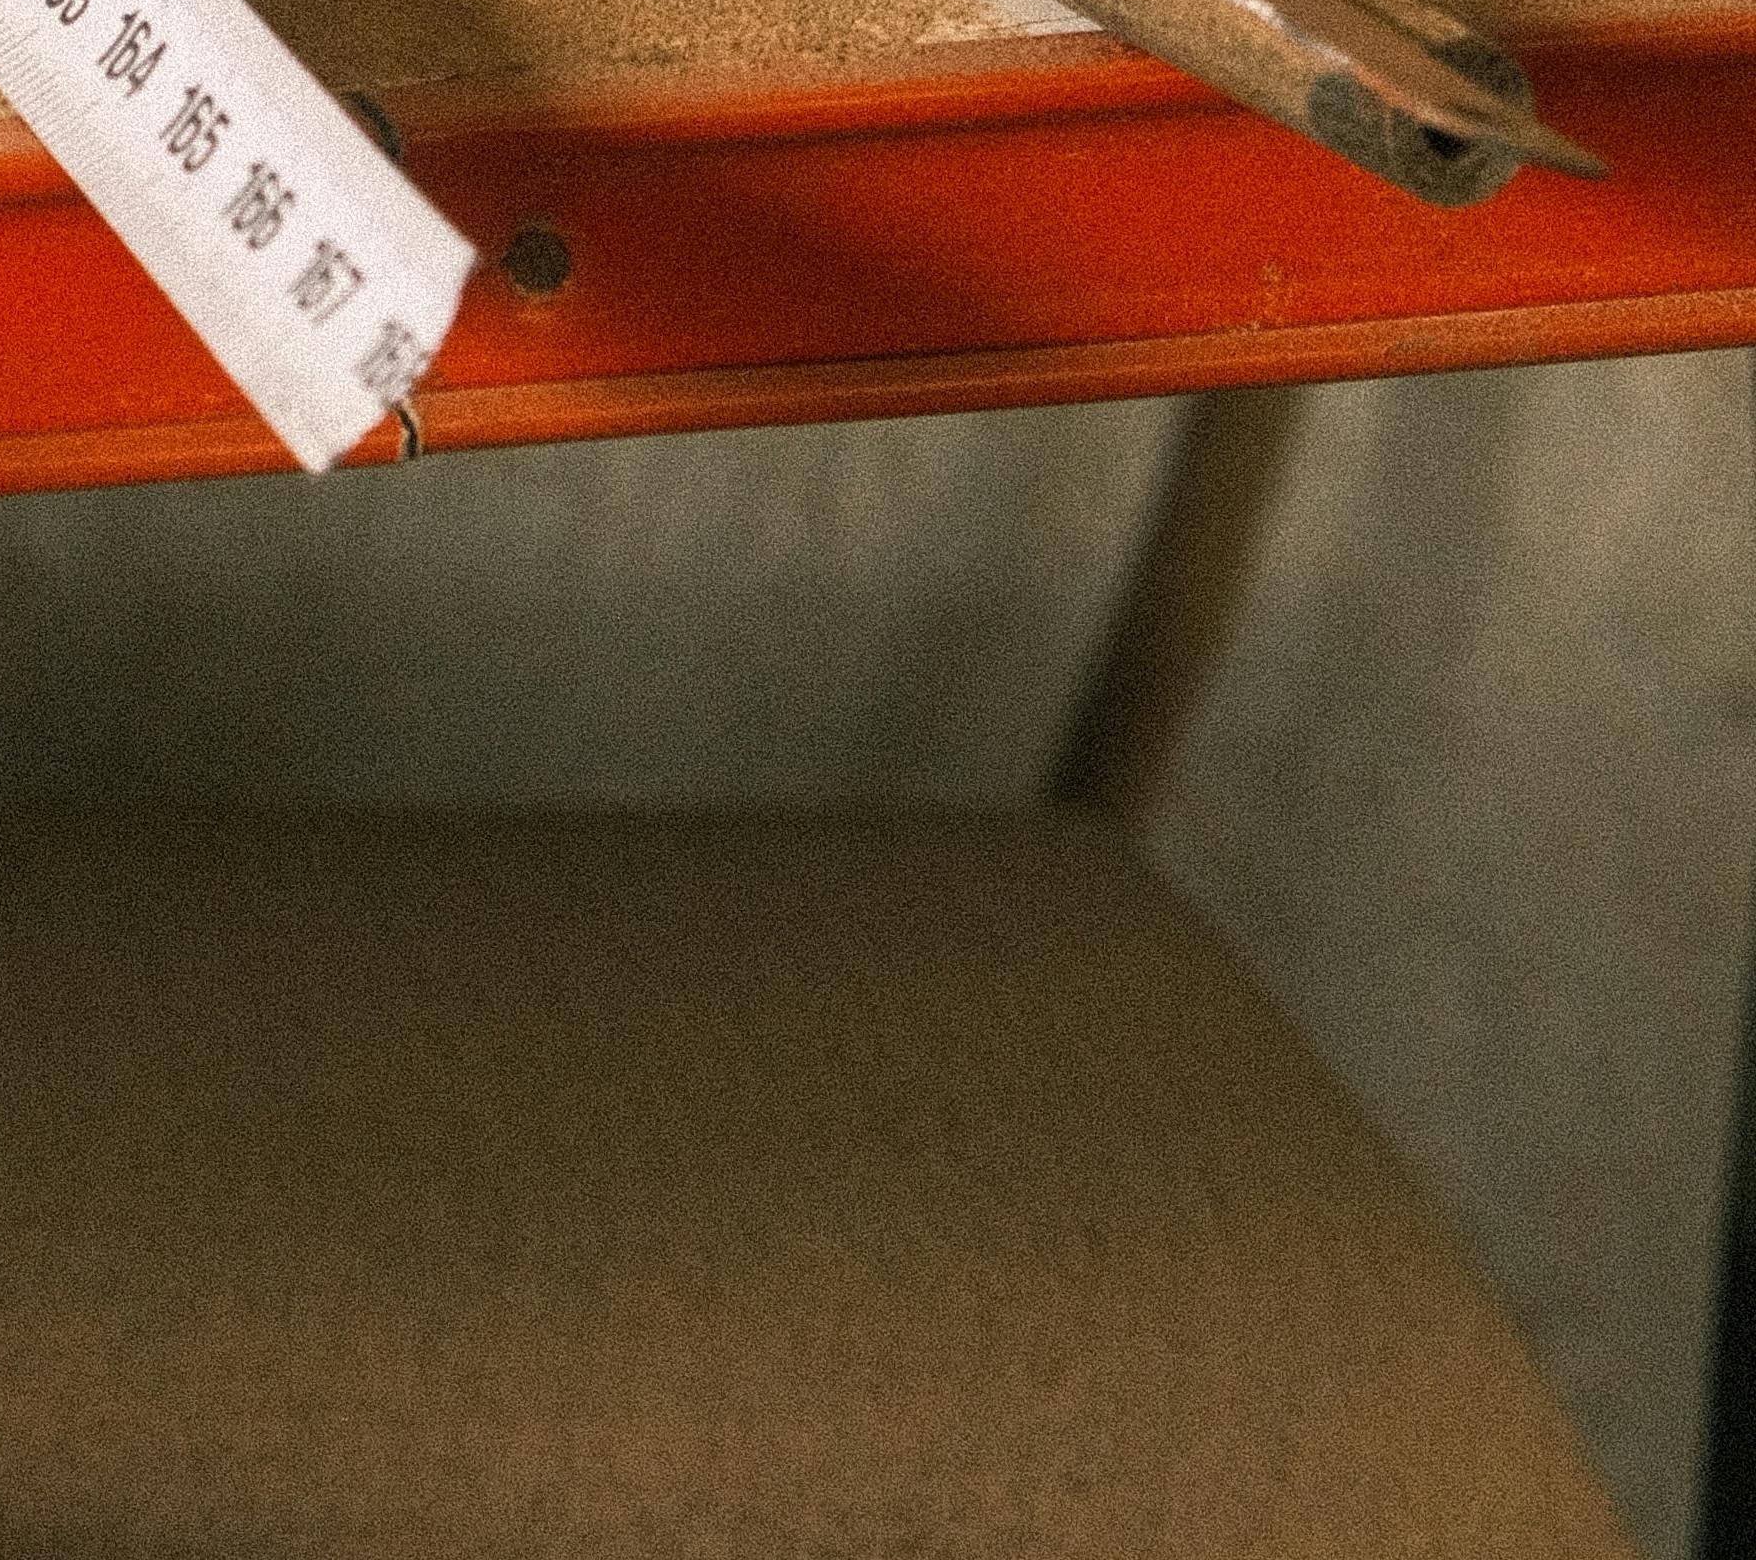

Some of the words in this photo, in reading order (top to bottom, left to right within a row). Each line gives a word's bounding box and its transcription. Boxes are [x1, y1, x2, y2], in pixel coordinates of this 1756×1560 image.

[96, 10, 168, 98] 164
[158, 83, 233, 174] 165
[220, 160, 298, 252] 166
[287, 237, 366, 326] 167
